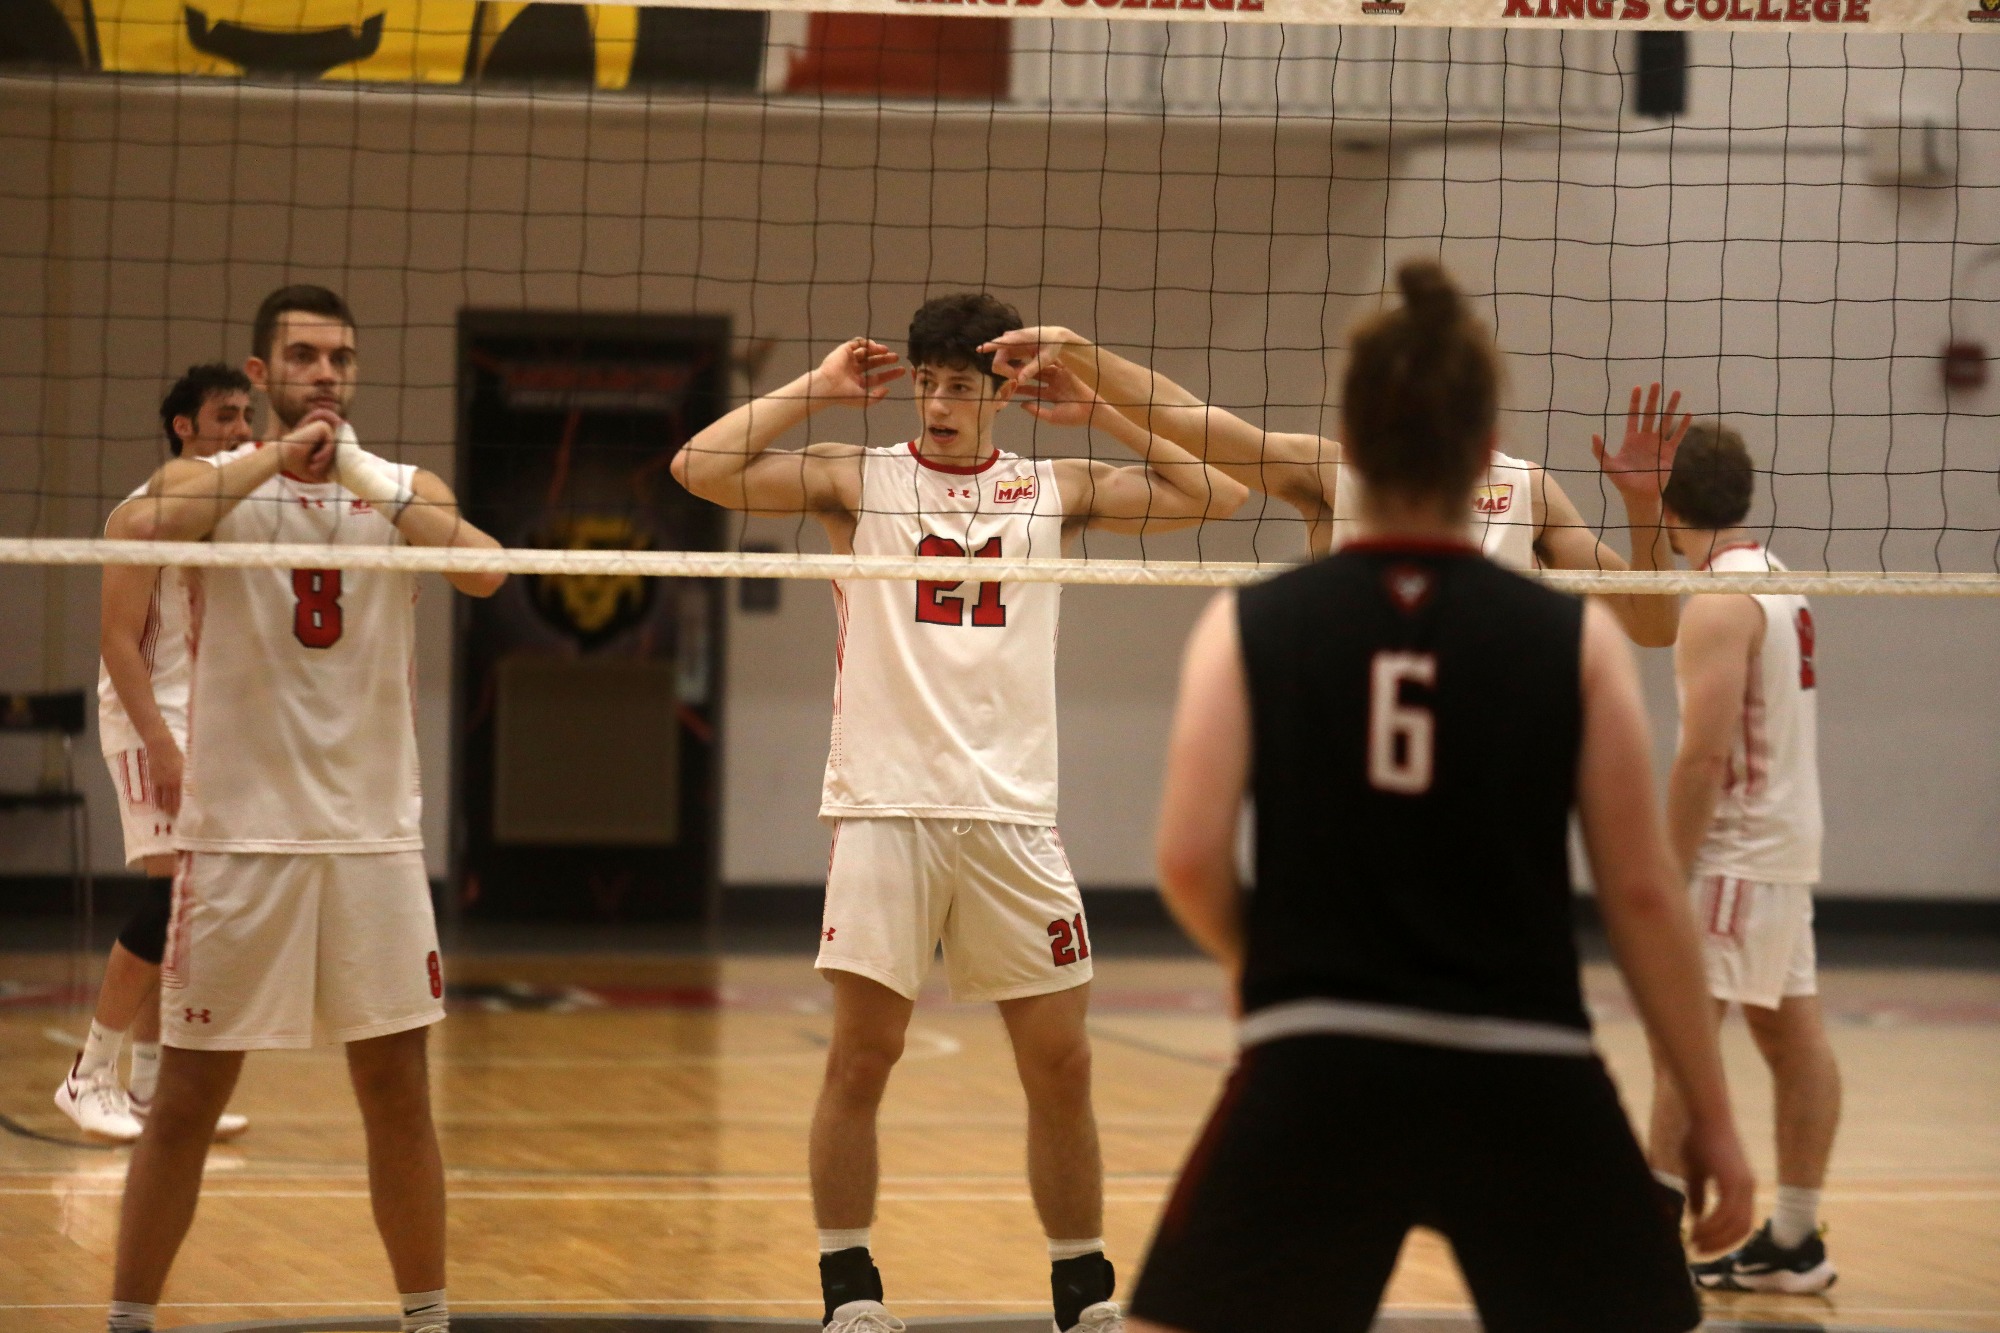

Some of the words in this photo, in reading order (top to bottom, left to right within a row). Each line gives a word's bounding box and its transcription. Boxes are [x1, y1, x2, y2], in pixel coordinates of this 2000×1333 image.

[1501, 0, 1650, 20] KINGS
[1664, 0, 1870, 23] COLLEGE
[291, 568, 342, 648] 8
[915, 533, 1006, 627] 21
[1368, 651, 1437, 793] 6
[1047, 912, 1089, 967] 21
